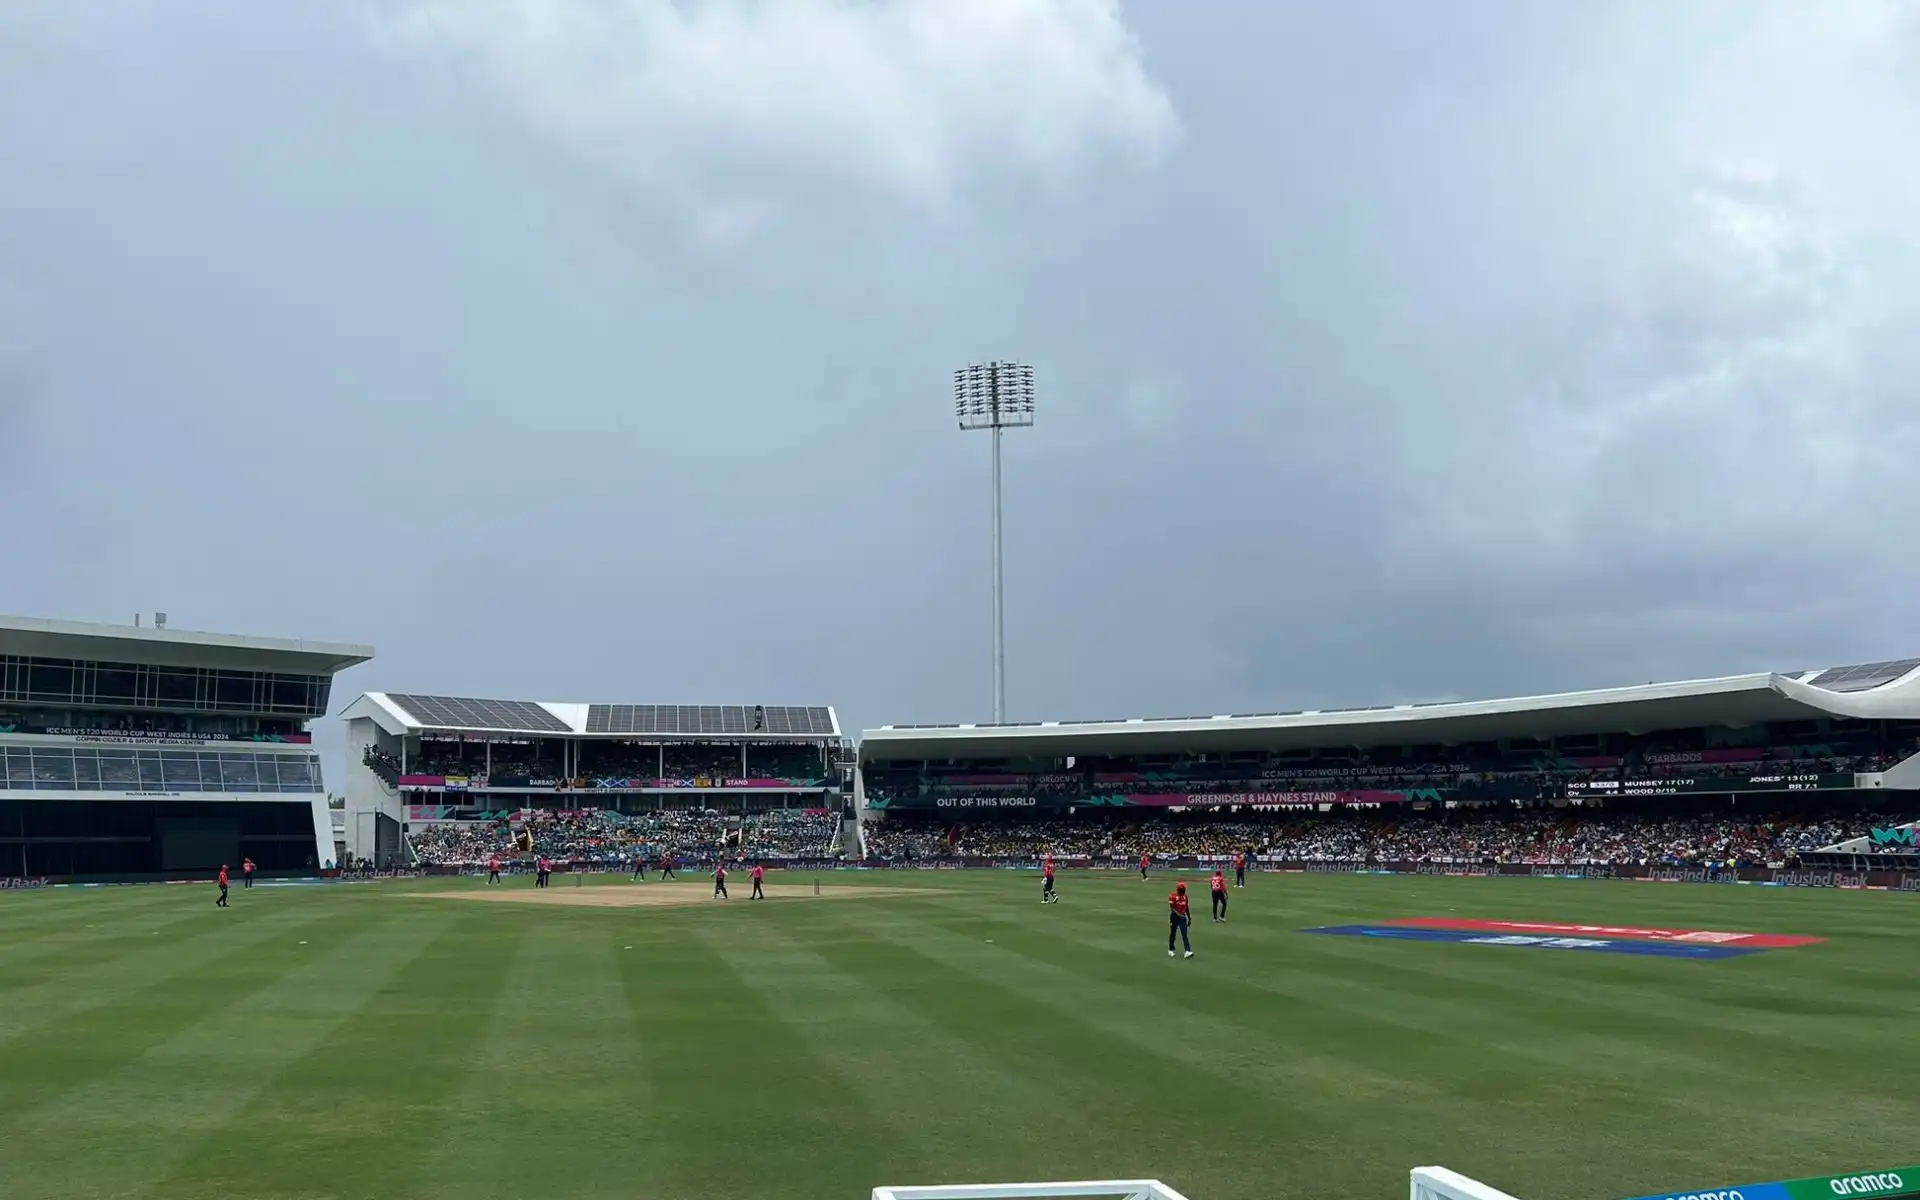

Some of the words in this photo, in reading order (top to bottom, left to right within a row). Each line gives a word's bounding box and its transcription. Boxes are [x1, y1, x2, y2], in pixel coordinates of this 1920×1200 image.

[61, 727, 85, 735] MEN'S
[1351, 767, 1368, 775] CUP
[1370, 766, 1393, 774] WEST
[936, 798, 957, 807] OUT
[959, 798, 973, 807] OF
[975, 797, 998, 807] THIS
[1000, 797, 1036, 806] WORLD
[1187, 794, 1246, 804] GREENIDGE
[1249, 794, 1255, 803] &
[1257, 793, 1299, 803] HAYNES
[1300, 792, 1337, 802] STAND
[571, 864, 621, 873] IndusInd
[786, 861, 835, 870] IndusInd
[836, 861, 864, 870] Bank
[889, 860, 938, 869] IndusInd
[939, 860, 966, 869] Bank
[991, 859, 1040, 869] IndusInd
[1250, 862, 1279, 871] Bank
[1306, 862, 1357, 872] IndusInd
[1358, 863, 1388, 873] Bank
[1416, 863, 1470, 874] IndusInd
[1471, 864, 1501, 875] Bank
[340, 868, 395, 879] IndusInd
[397, 867, 427, 878] Bank
[1531, 865, 1584, 876] IndusInd
[1648, 866, 1706, 881] IndusInd
[12, 876, 49, 889] Bank
[1771, 869, 1832, 885] IndusInd
[1833, 872, 1869, 886] Bank
[1830, 1172, 1904, 1195] aramco
